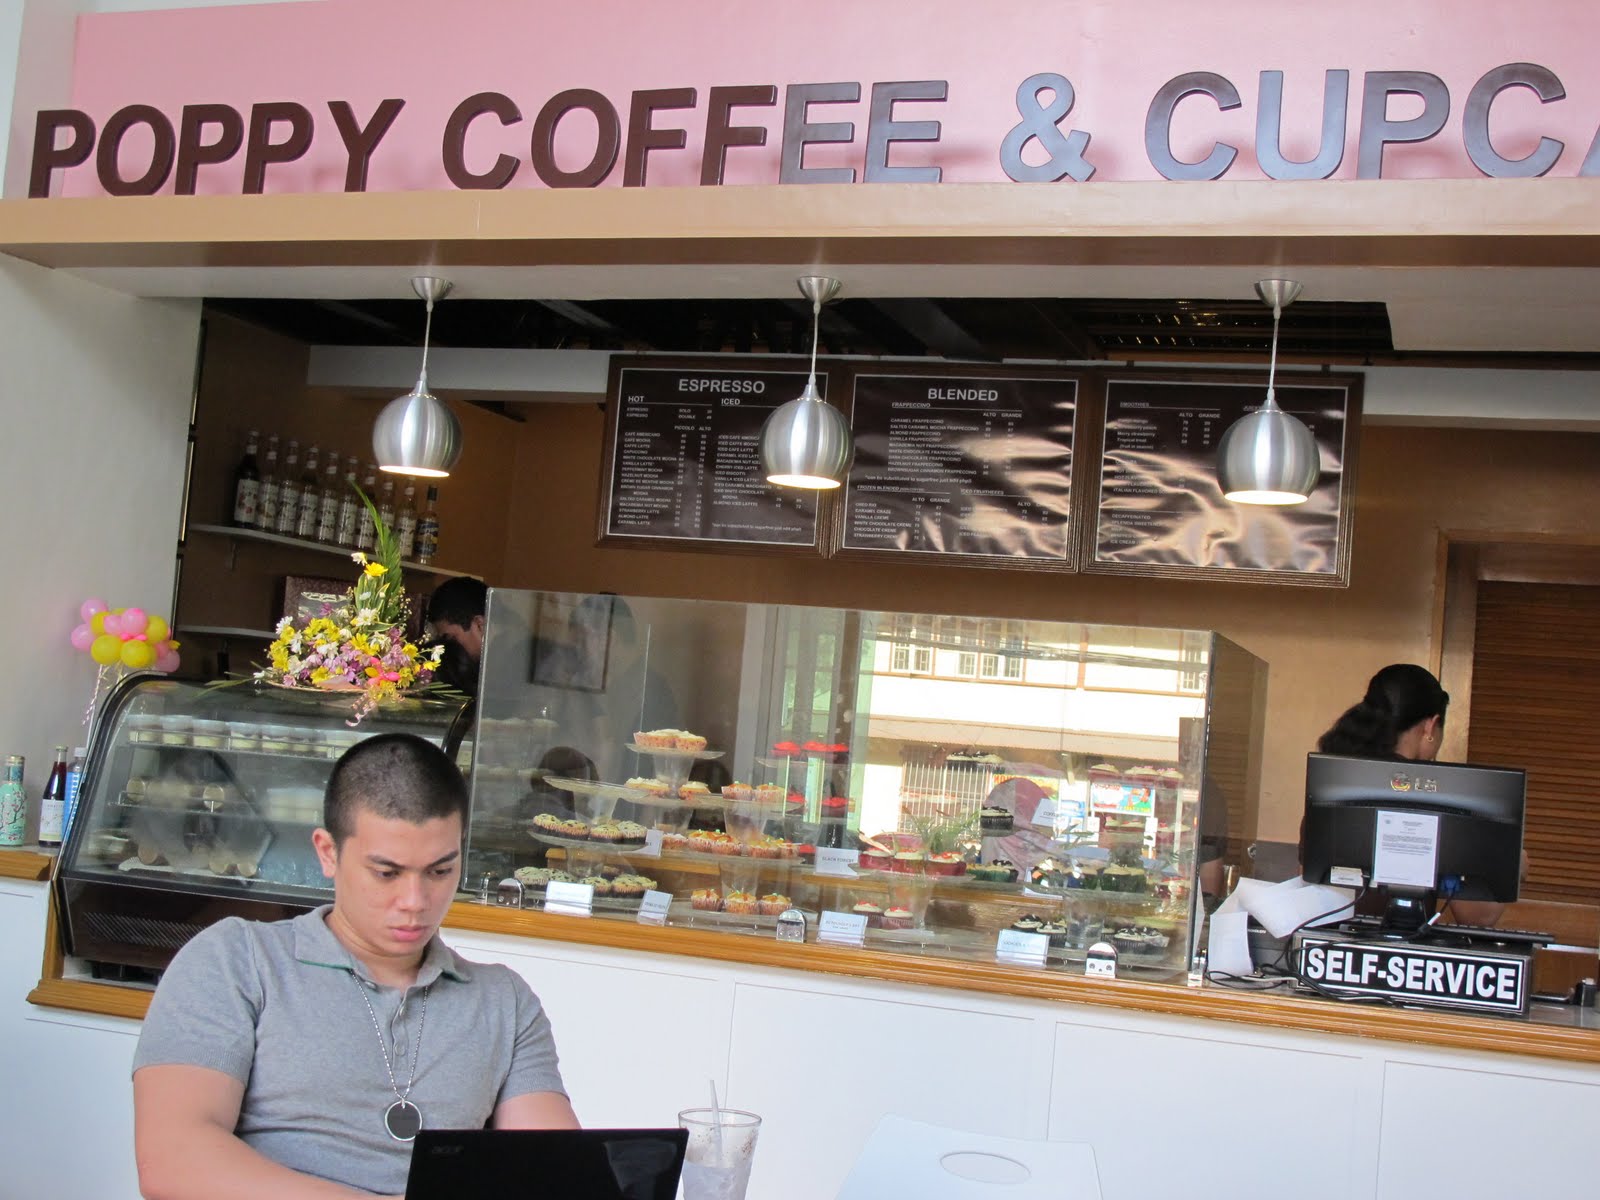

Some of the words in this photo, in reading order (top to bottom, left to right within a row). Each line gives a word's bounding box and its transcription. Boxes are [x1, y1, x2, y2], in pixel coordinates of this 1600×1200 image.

[28, 98, 405, 198] POPPY
[442, 80, 948, 190] COFFEE
[1000, 72, 1096, 183] &
[678, 378, 765, 393] ESPRESSO
[628, 395, 644, 403] HOT
[928, 388, 998, 401] BLENDED
[721, 398, 740, 406] ICED
[1307, 948, 1516, 1001] SELF-SERVICE
